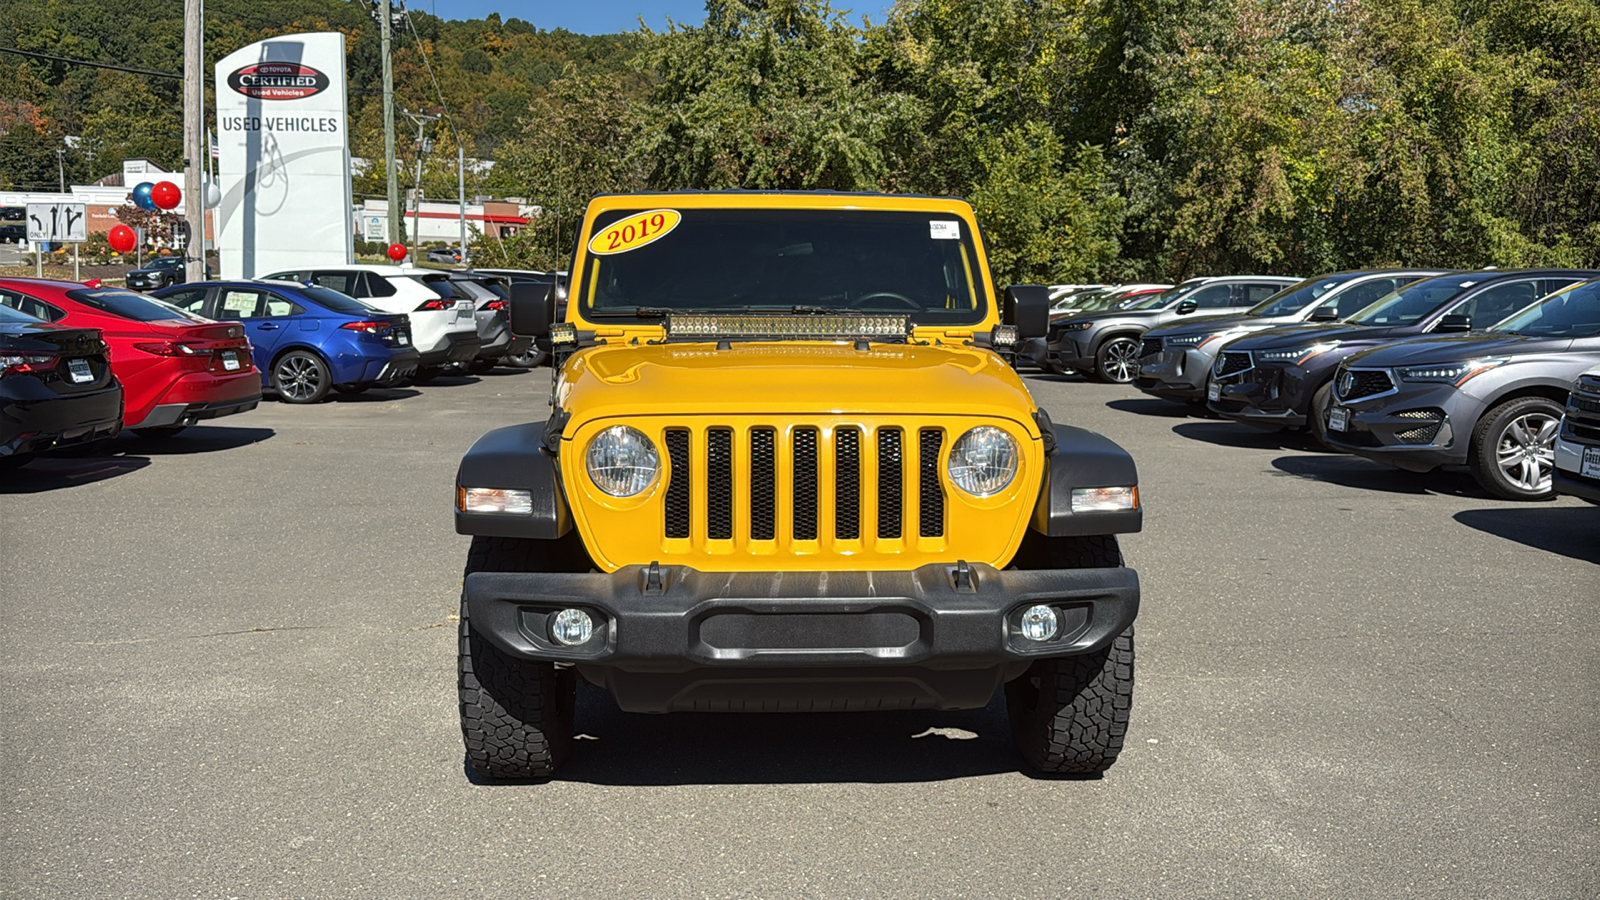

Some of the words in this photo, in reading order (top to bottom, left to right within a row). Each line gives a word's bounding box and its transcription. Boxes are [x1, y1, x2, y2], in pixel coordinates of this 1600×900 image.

[239, 74, 317, 87] CERTIFIED
[223, 117, 261, 131] USED
[266, 117, 337, 132] VEHICLES
[607, 213, 665, 251] 2019
